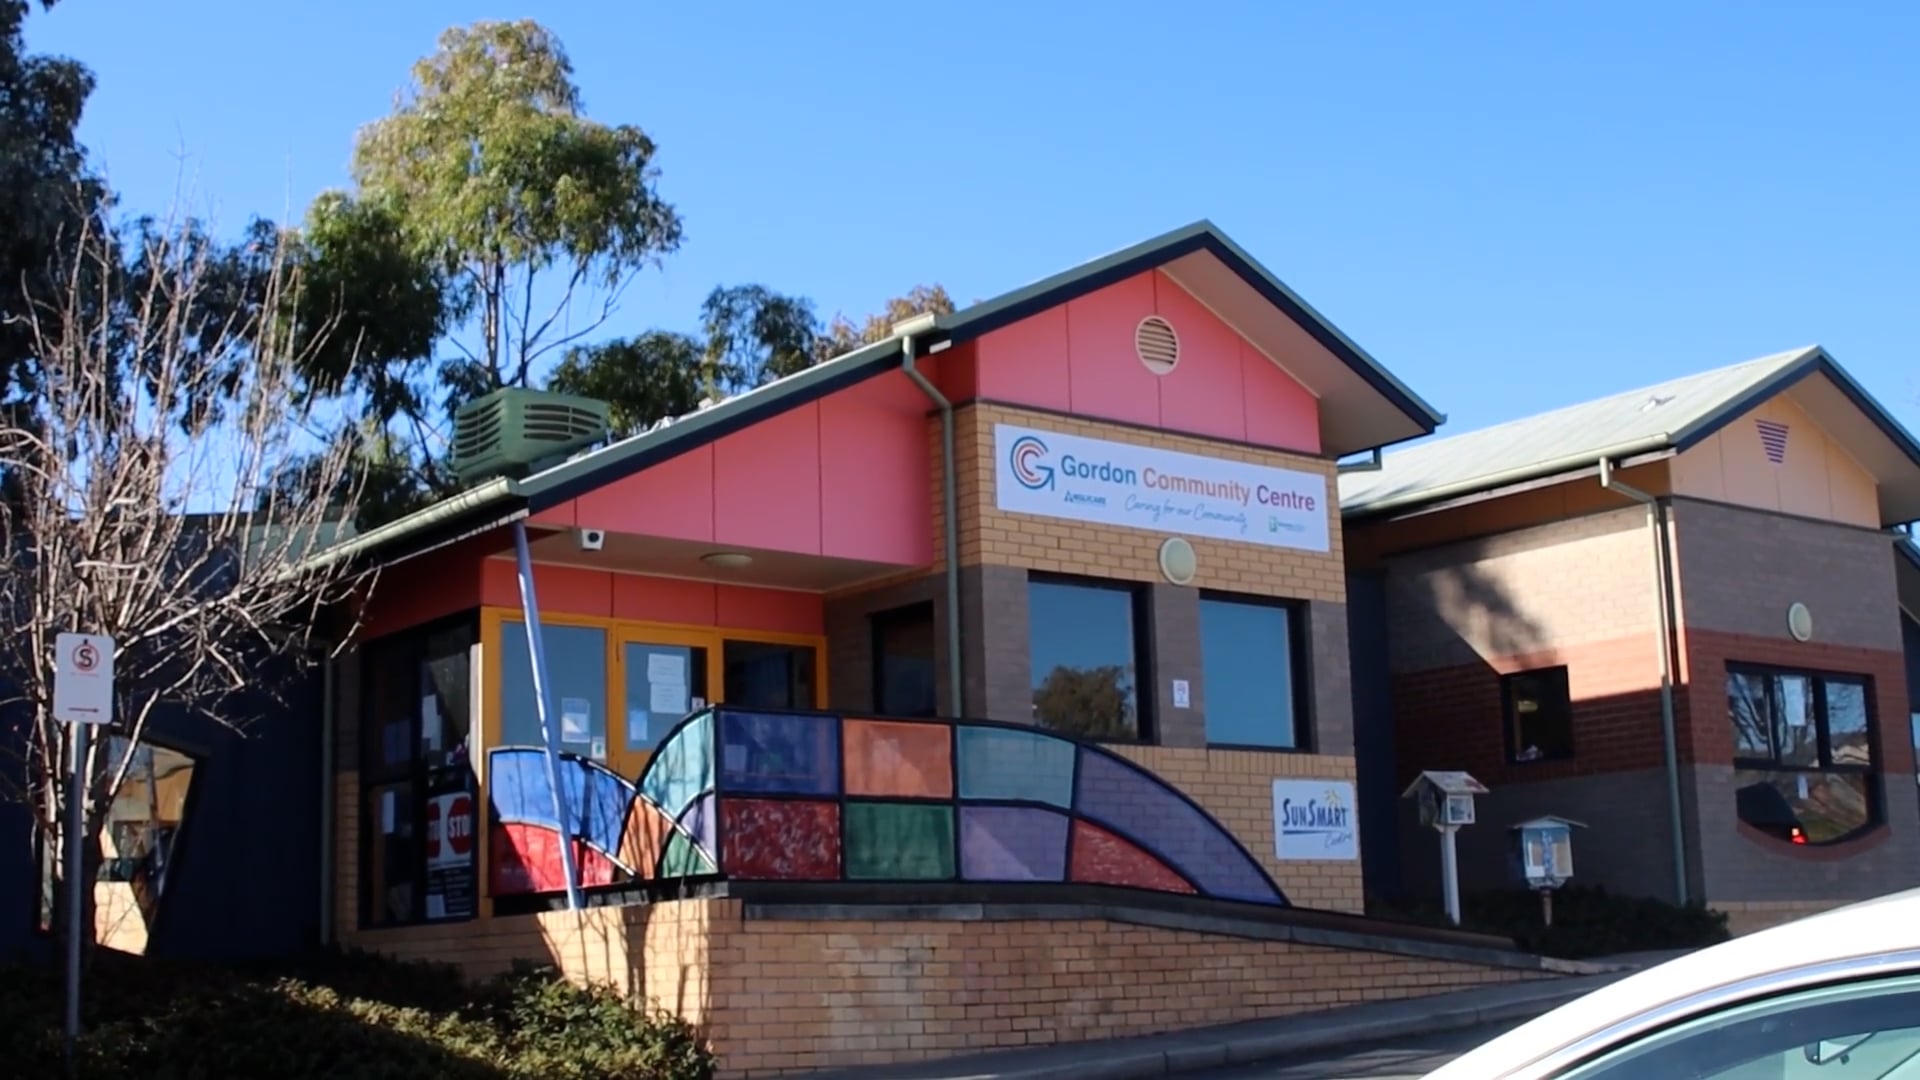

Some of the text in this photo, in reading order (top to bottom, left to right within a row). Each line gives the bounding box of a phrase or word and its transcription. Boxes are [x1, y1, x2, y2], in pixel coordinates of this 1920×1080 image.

[1061, 454, 1316, 512] Gordon Community Centre
[1193, 503, 1248, 534] Community
